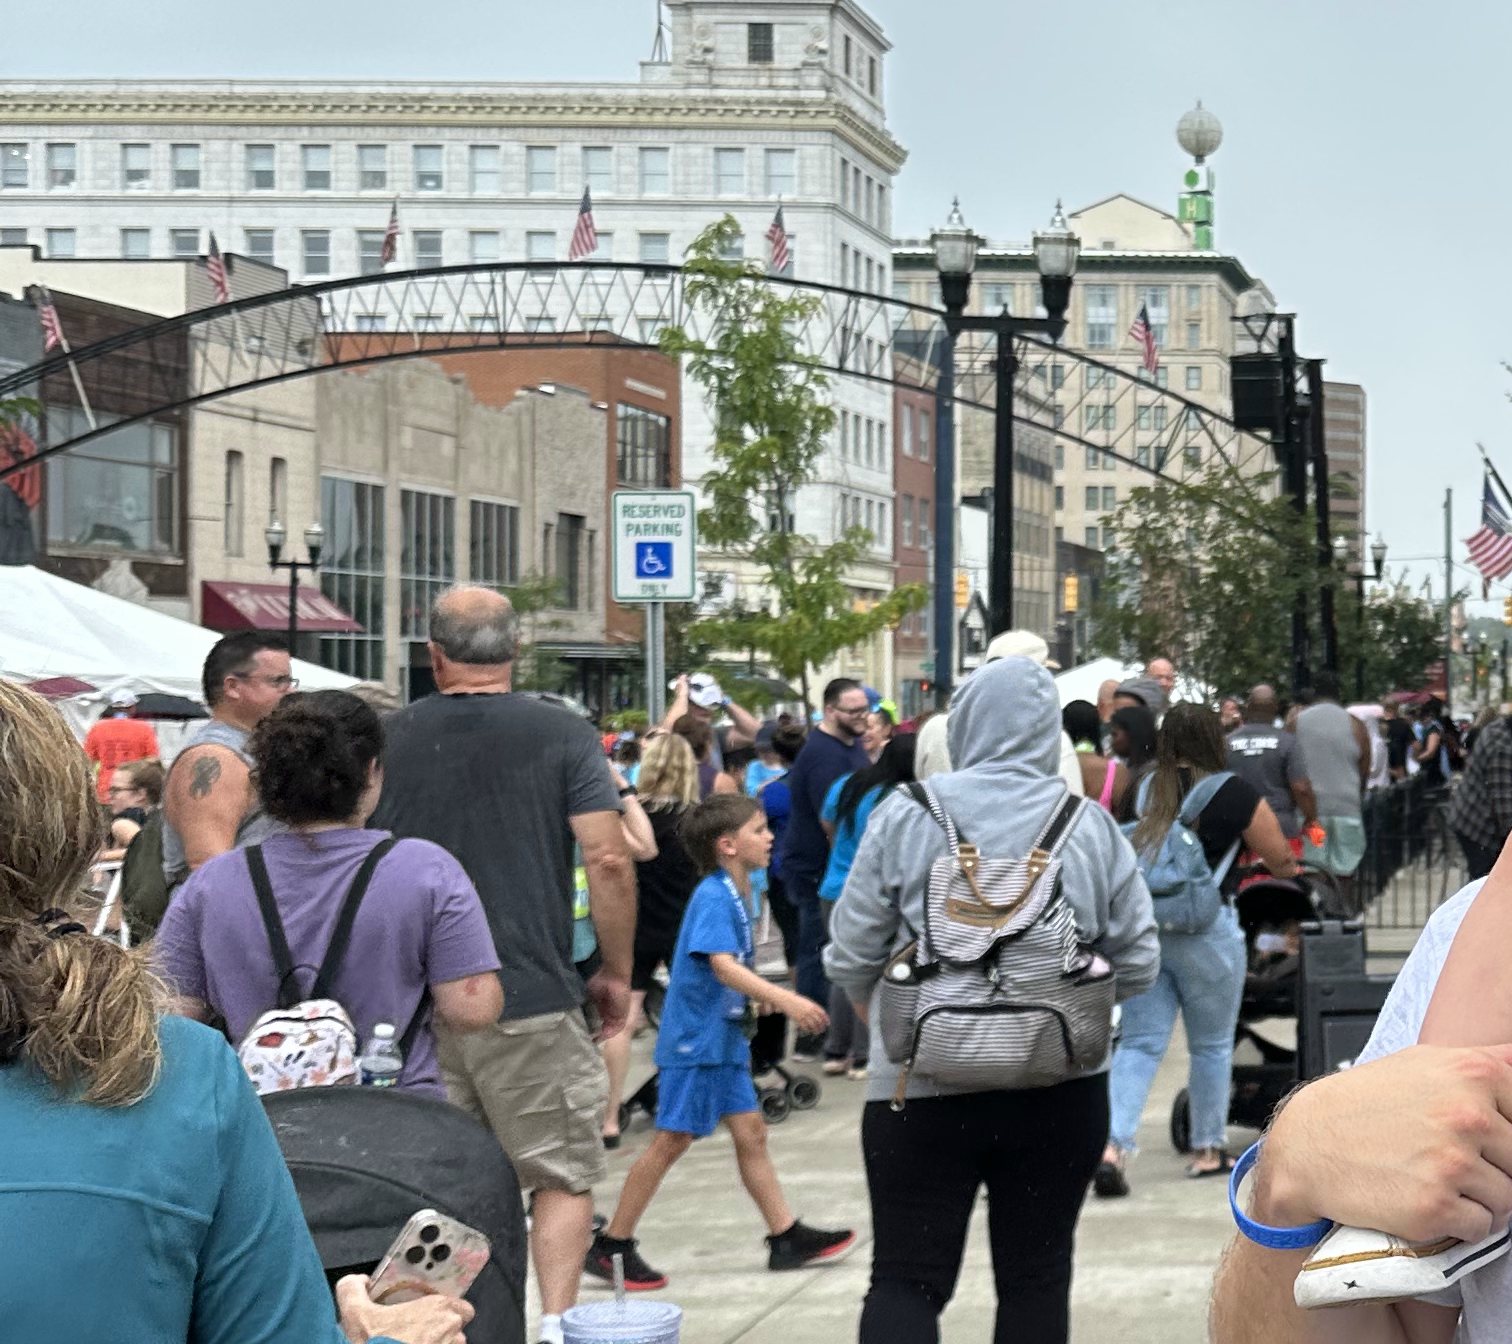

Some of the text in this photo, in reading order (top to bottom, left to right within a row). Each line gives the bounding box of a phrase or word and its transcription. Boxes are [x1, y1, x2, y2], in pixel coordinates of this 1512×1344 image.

[622, 504, 686, 518] RESERVED
[625, 523, 682, 537] PARKING
[641, 583, 668, 595] ONLY
